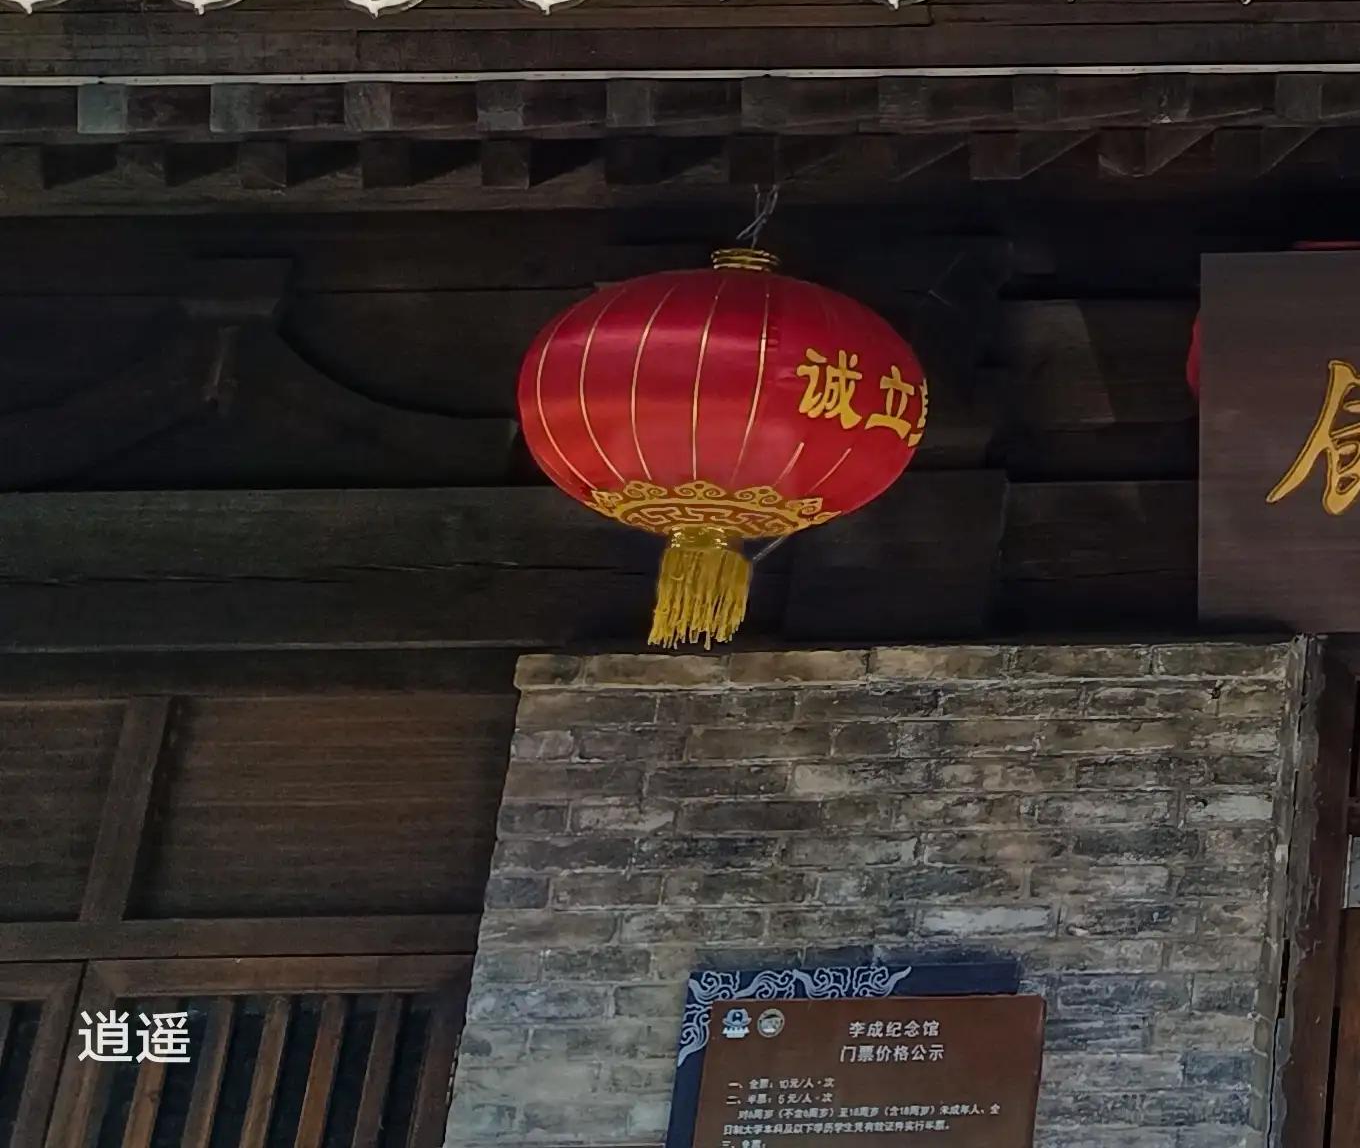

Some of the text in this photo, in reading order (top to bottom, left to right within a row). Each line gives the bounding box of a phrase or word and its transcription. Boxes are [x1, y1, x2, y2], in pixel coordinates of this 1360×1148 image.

[797, 348, 929, 449] 诚立
[849, 1020, 940, 1038] 李成纪念馆
[840, 1044, 945, 1063] 门票价格公示
